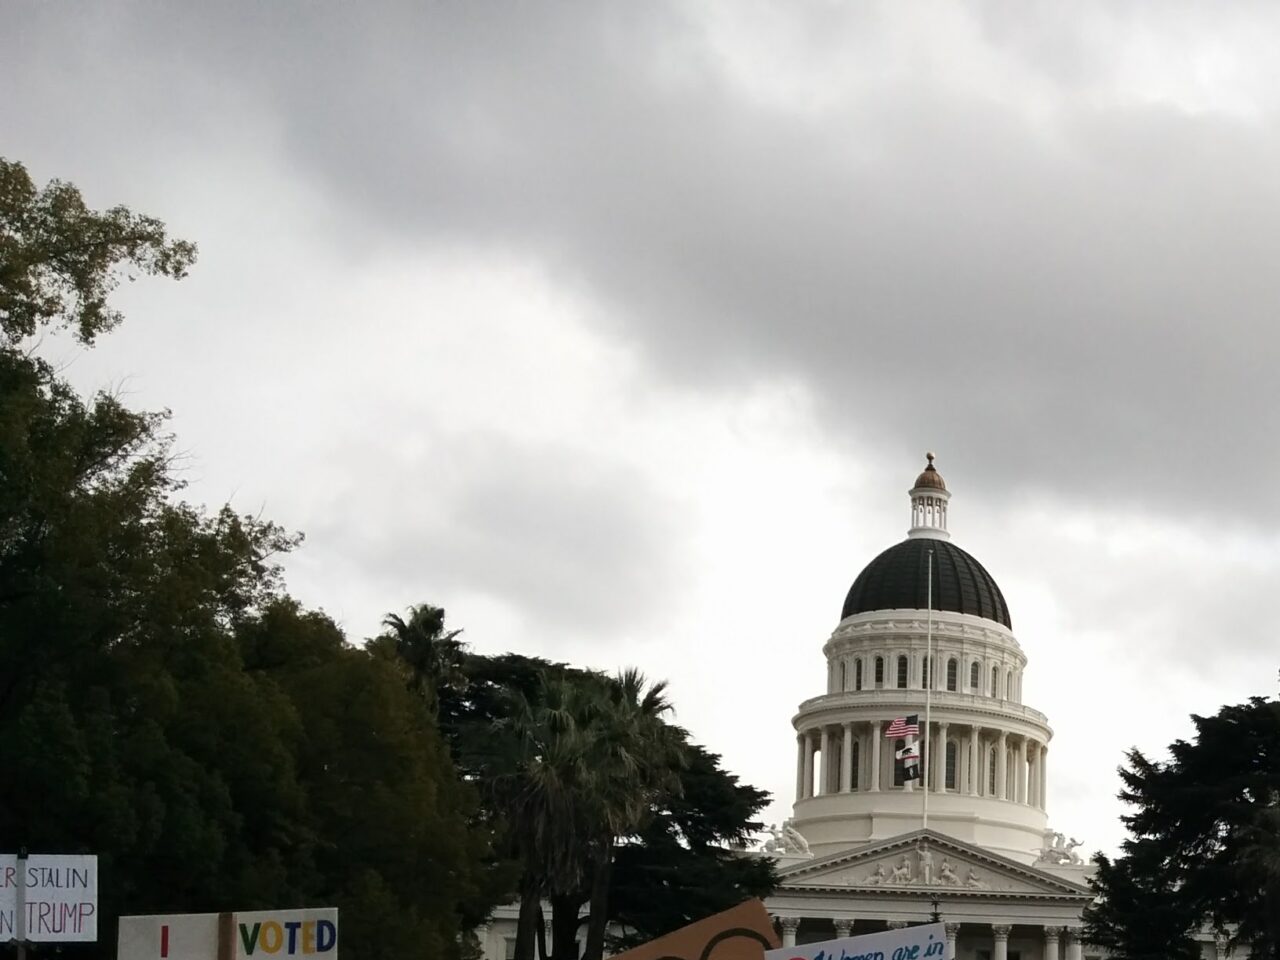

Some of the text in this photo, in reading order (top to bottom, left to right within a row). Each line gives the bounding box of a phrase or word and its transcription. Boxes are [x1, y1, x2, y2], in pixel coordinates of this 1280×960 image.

[25, 866, 88, 889] STALIN
[25, 901, 95, 934] TRUMP
[160, 918, 336, 958] I VOTED
[923, 934, 945, 956] in
